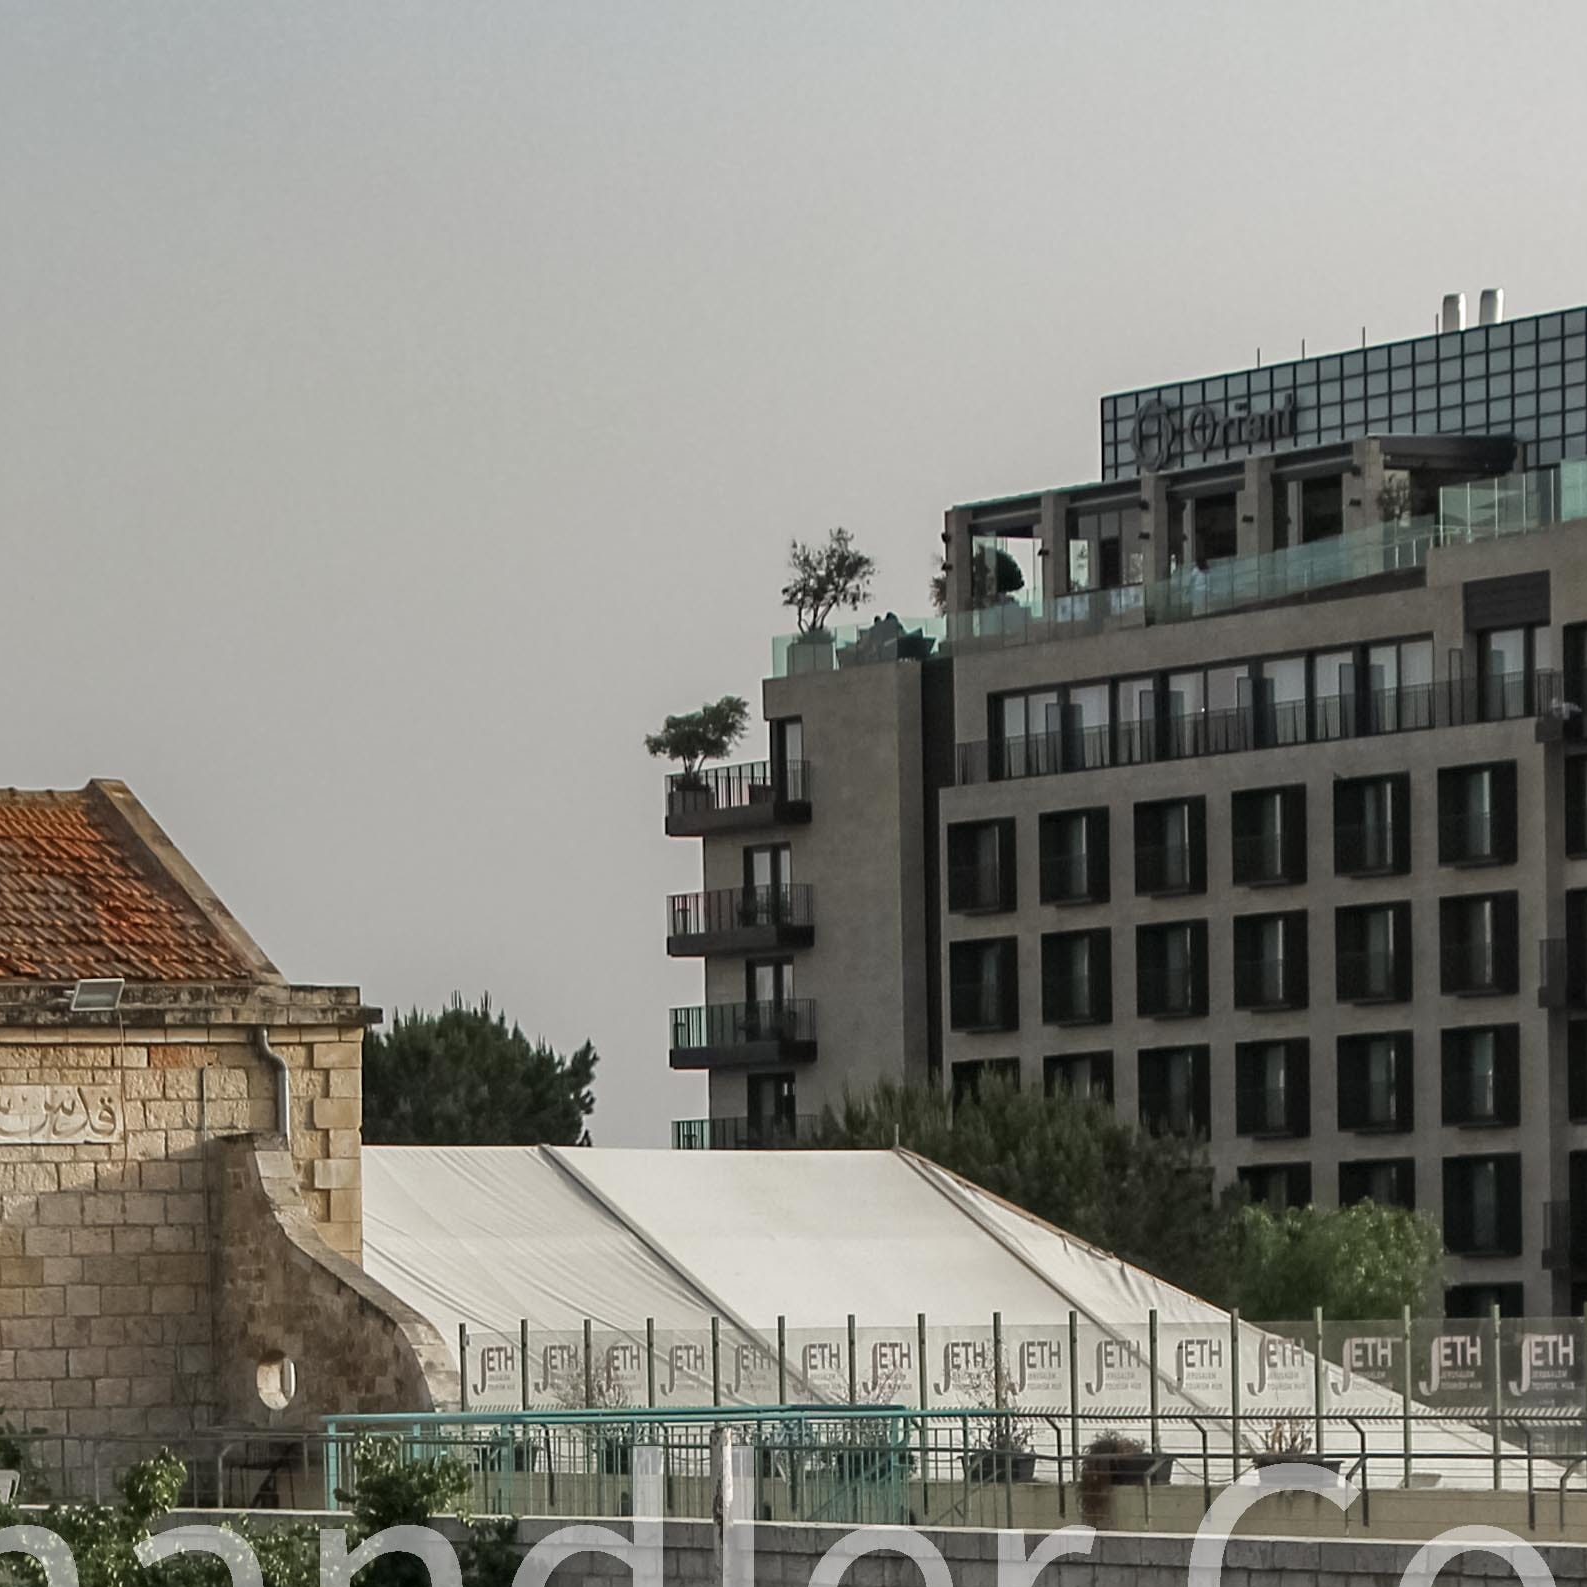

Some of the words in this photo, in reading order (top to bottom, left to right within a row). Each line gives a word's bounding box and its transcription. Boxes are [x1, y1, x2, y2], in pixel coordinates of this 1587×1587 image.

[1188, 393, 1295, 450] Orient
[473, 1346, 515, 1396] JETH
[534, 1345, 578, 1394] JETH
[598, 1345, 641, 1393] JETH
[660, 1344, 705, 1396] JETH
[725, 1344, 771, 1395] JETH
[793, 1344, 841, 1396] JETH
[863, 1342, 911, 1395] JETH
[933, 1342, 985, 1395] JETH
[1007, 1341, 1061, 1395] JETH
[1085, 1340, 1140, 1396] JETH
[1165, 1339, 1222, 1395] JETH
[1247, 1337, 1305, 1396] JETH
[1331, 1337, 1392, 1396] JETH
[1419, 1336, 1481, 1396] JETH
[1509, 1334, 1574, 1396] JETH
